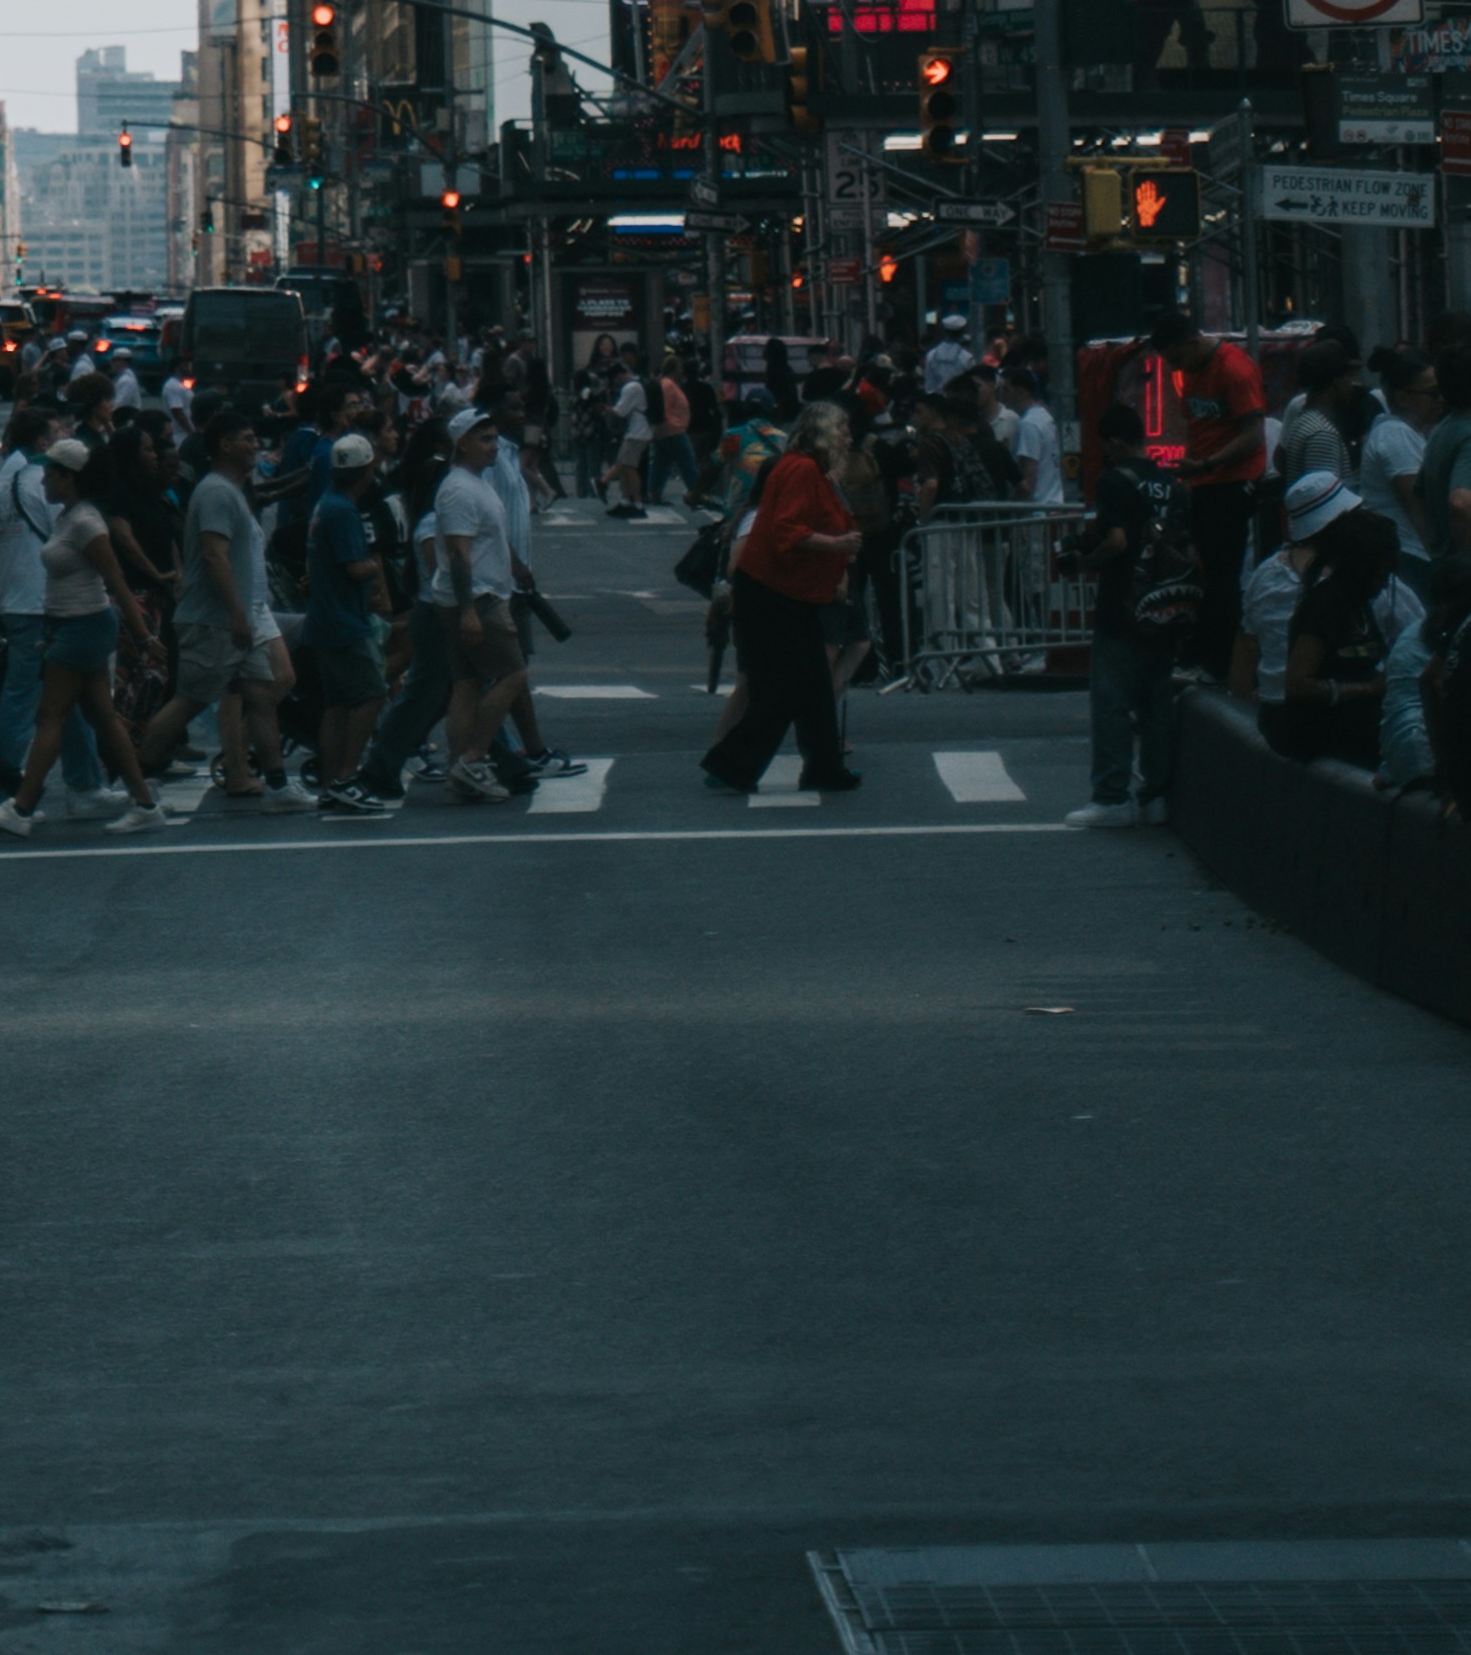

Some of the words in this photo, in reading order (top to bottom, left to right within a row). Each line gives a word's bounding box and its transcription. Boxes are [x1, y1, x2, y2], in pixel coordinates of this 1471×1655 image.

[1407, 30, 1465, 55] TIMES
[1342, 90, 1375, 104] Times
[1376, 91, 1418, 105] Square
[1272, 174, 1352, 195] PEDESTRIAN
[1356, 176, 1391, 196] FLOW
[1394, 180, 1429, 199] ZONE
[945, 205, 971, 219] ONE
[1342, 197, 1376, 216] KEEP
[1379, 201, 1430, 221] MOVING
